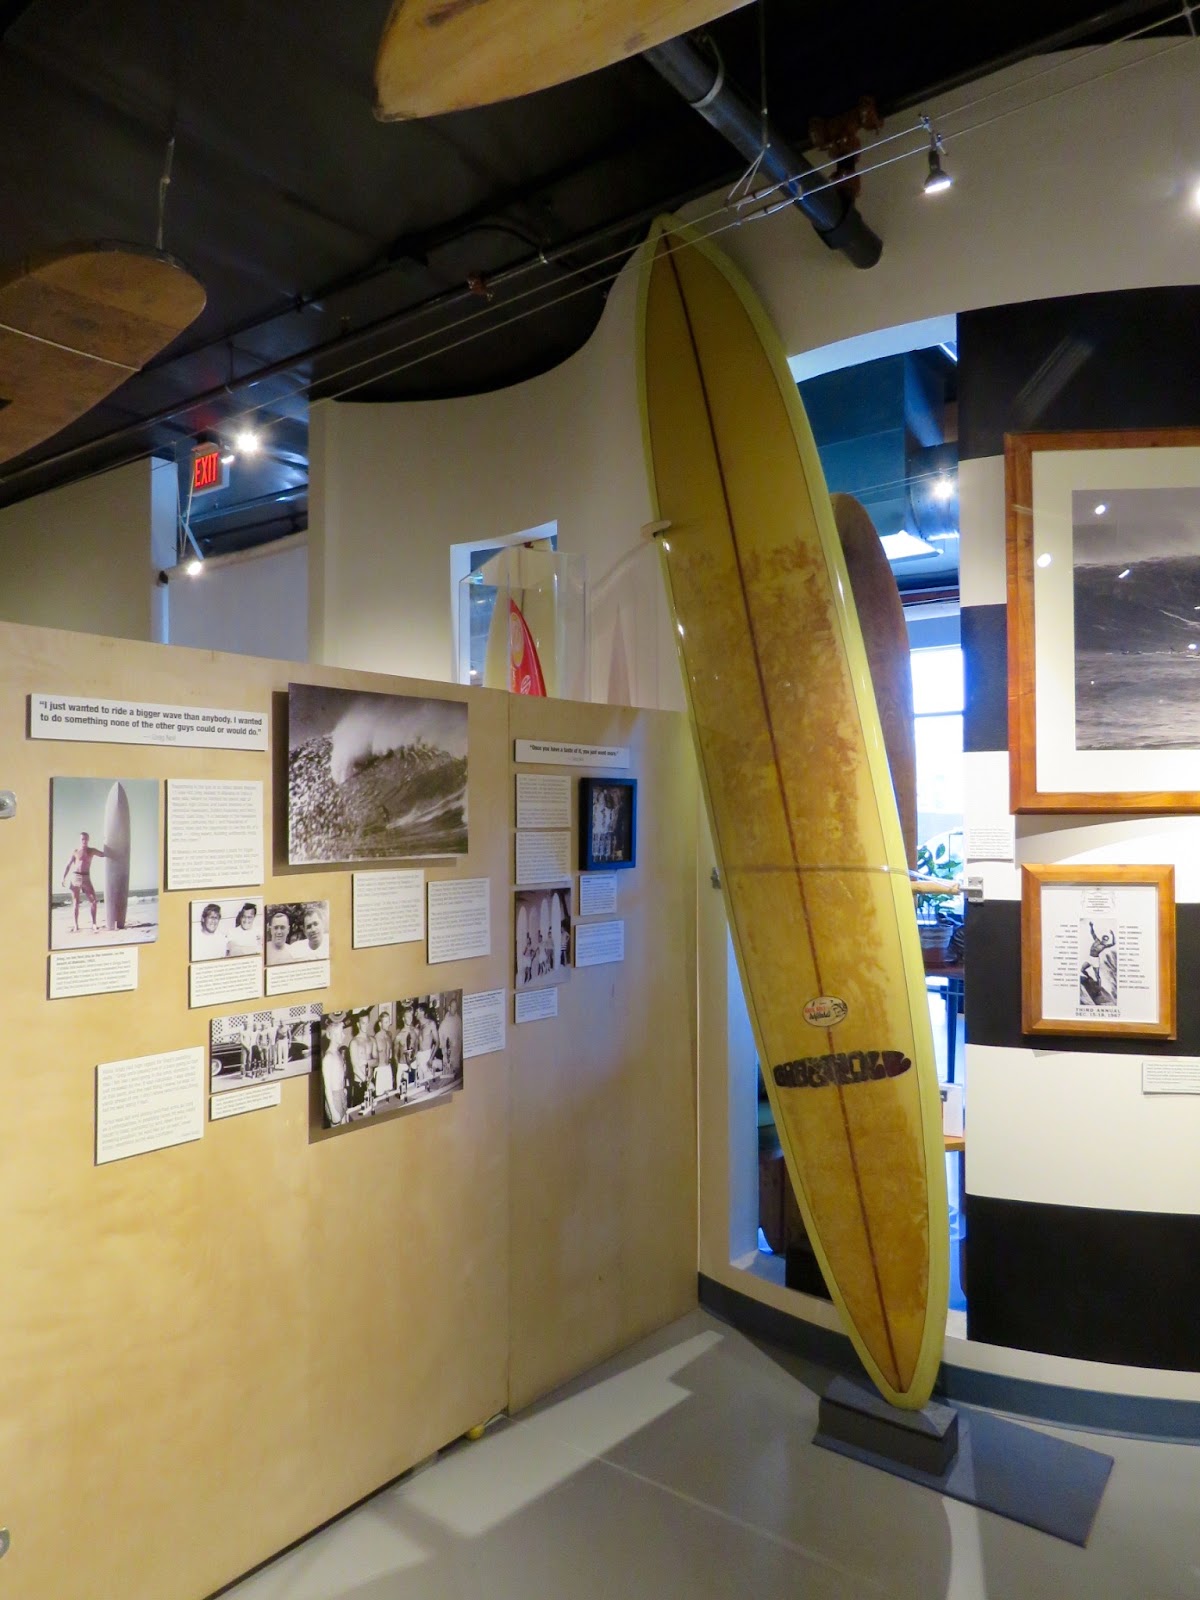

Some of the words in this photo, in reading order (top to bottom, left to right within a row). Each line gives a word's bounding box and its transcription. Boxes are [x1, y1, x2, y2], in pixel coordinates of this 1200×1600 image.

[195, 452, 218, 487] EXIT
[40, 713, 49, 721] to
[51, 713, 62, 722] do
[64, 715, 108, 727] something
[110, 718, 130, 727] none
[131, 719, 140, 728] of
[141, 720, 154, 729] the
[155, 721, 175, 730] other
[177, 723, 194, 732] guys
[196, 724, 215, 733] could
[226, 727, 246, 735] would
[50, 701, 66, 711] just
[68, 704, 99, 713] wanted
[101, 705, 110, 714] to
[111, 706, 127, 715] ride
[136, 708, 160, 719] bigger
[162, 711, 182, 720] wave
[184, 712, 200, 721] than
[201, 714, 232, 724] anybody.
[238, 717, 262, 725] wanted
